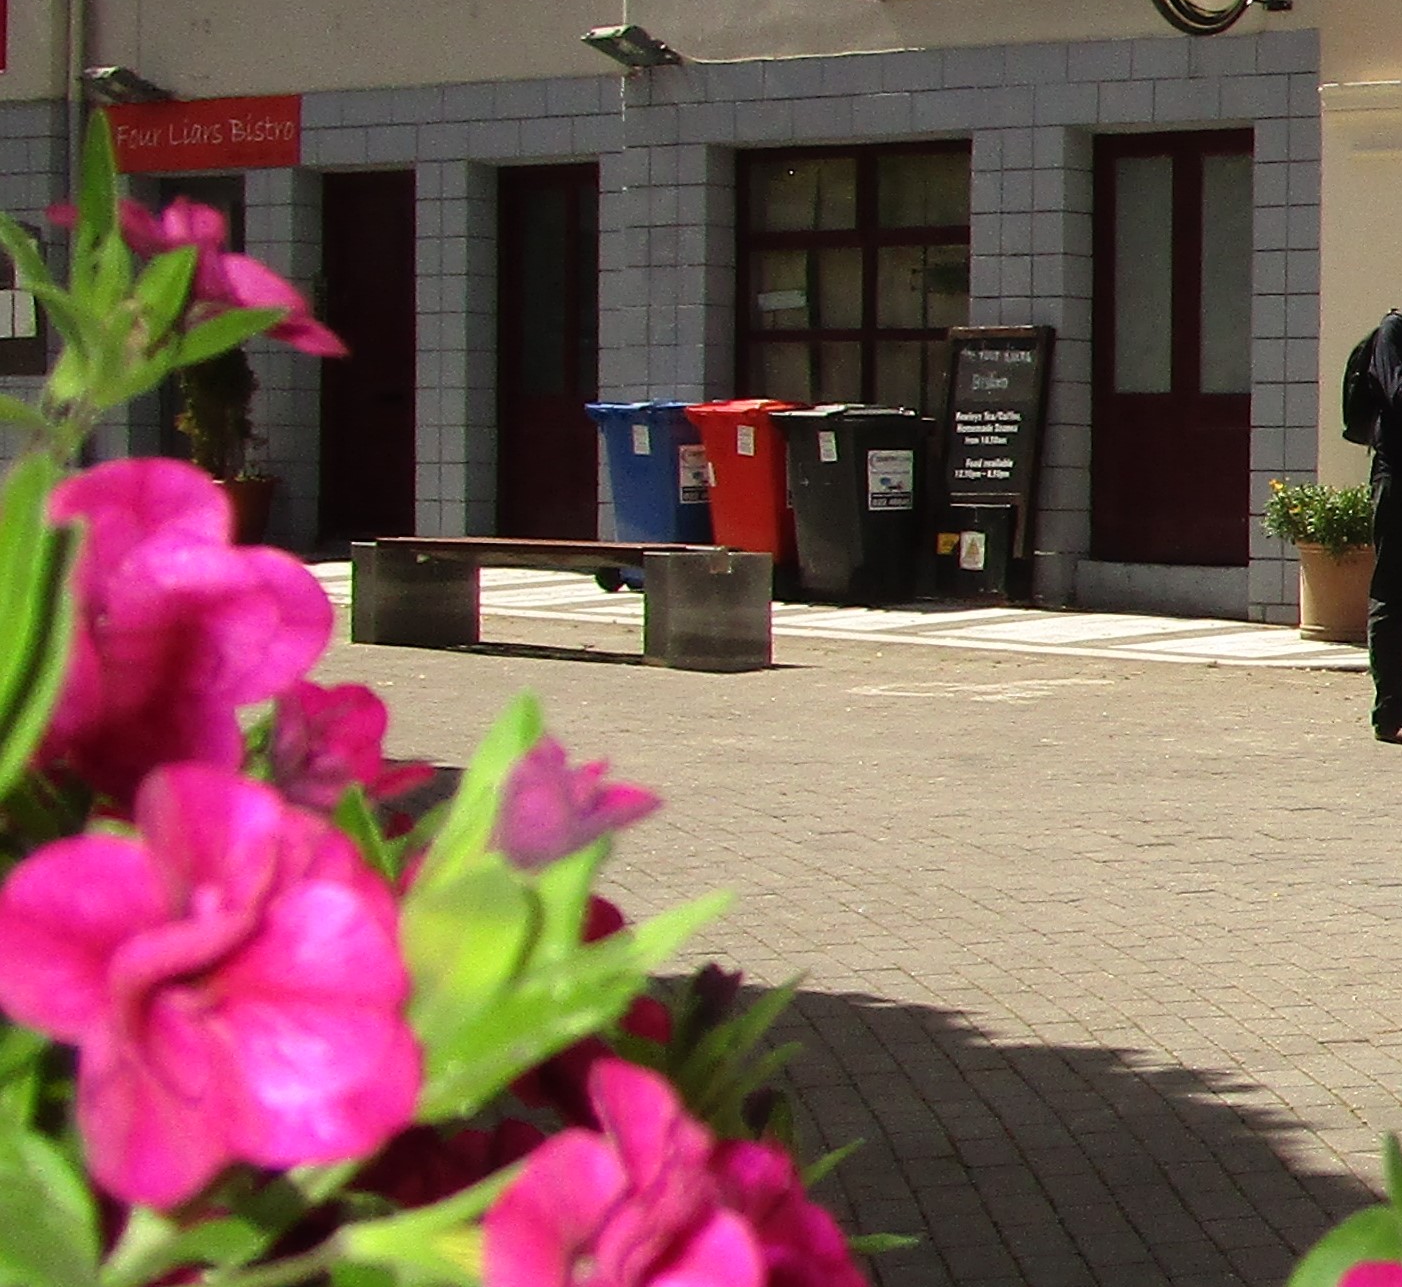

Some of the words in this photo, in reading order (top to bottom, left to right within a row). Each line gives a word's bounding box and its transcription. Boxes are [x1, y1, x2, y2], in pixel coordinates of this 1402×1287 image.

[116, 125, 163, 150] Four
[168, 118, 224, 146] Liars
[229, 112, 295, 144] Bistro
